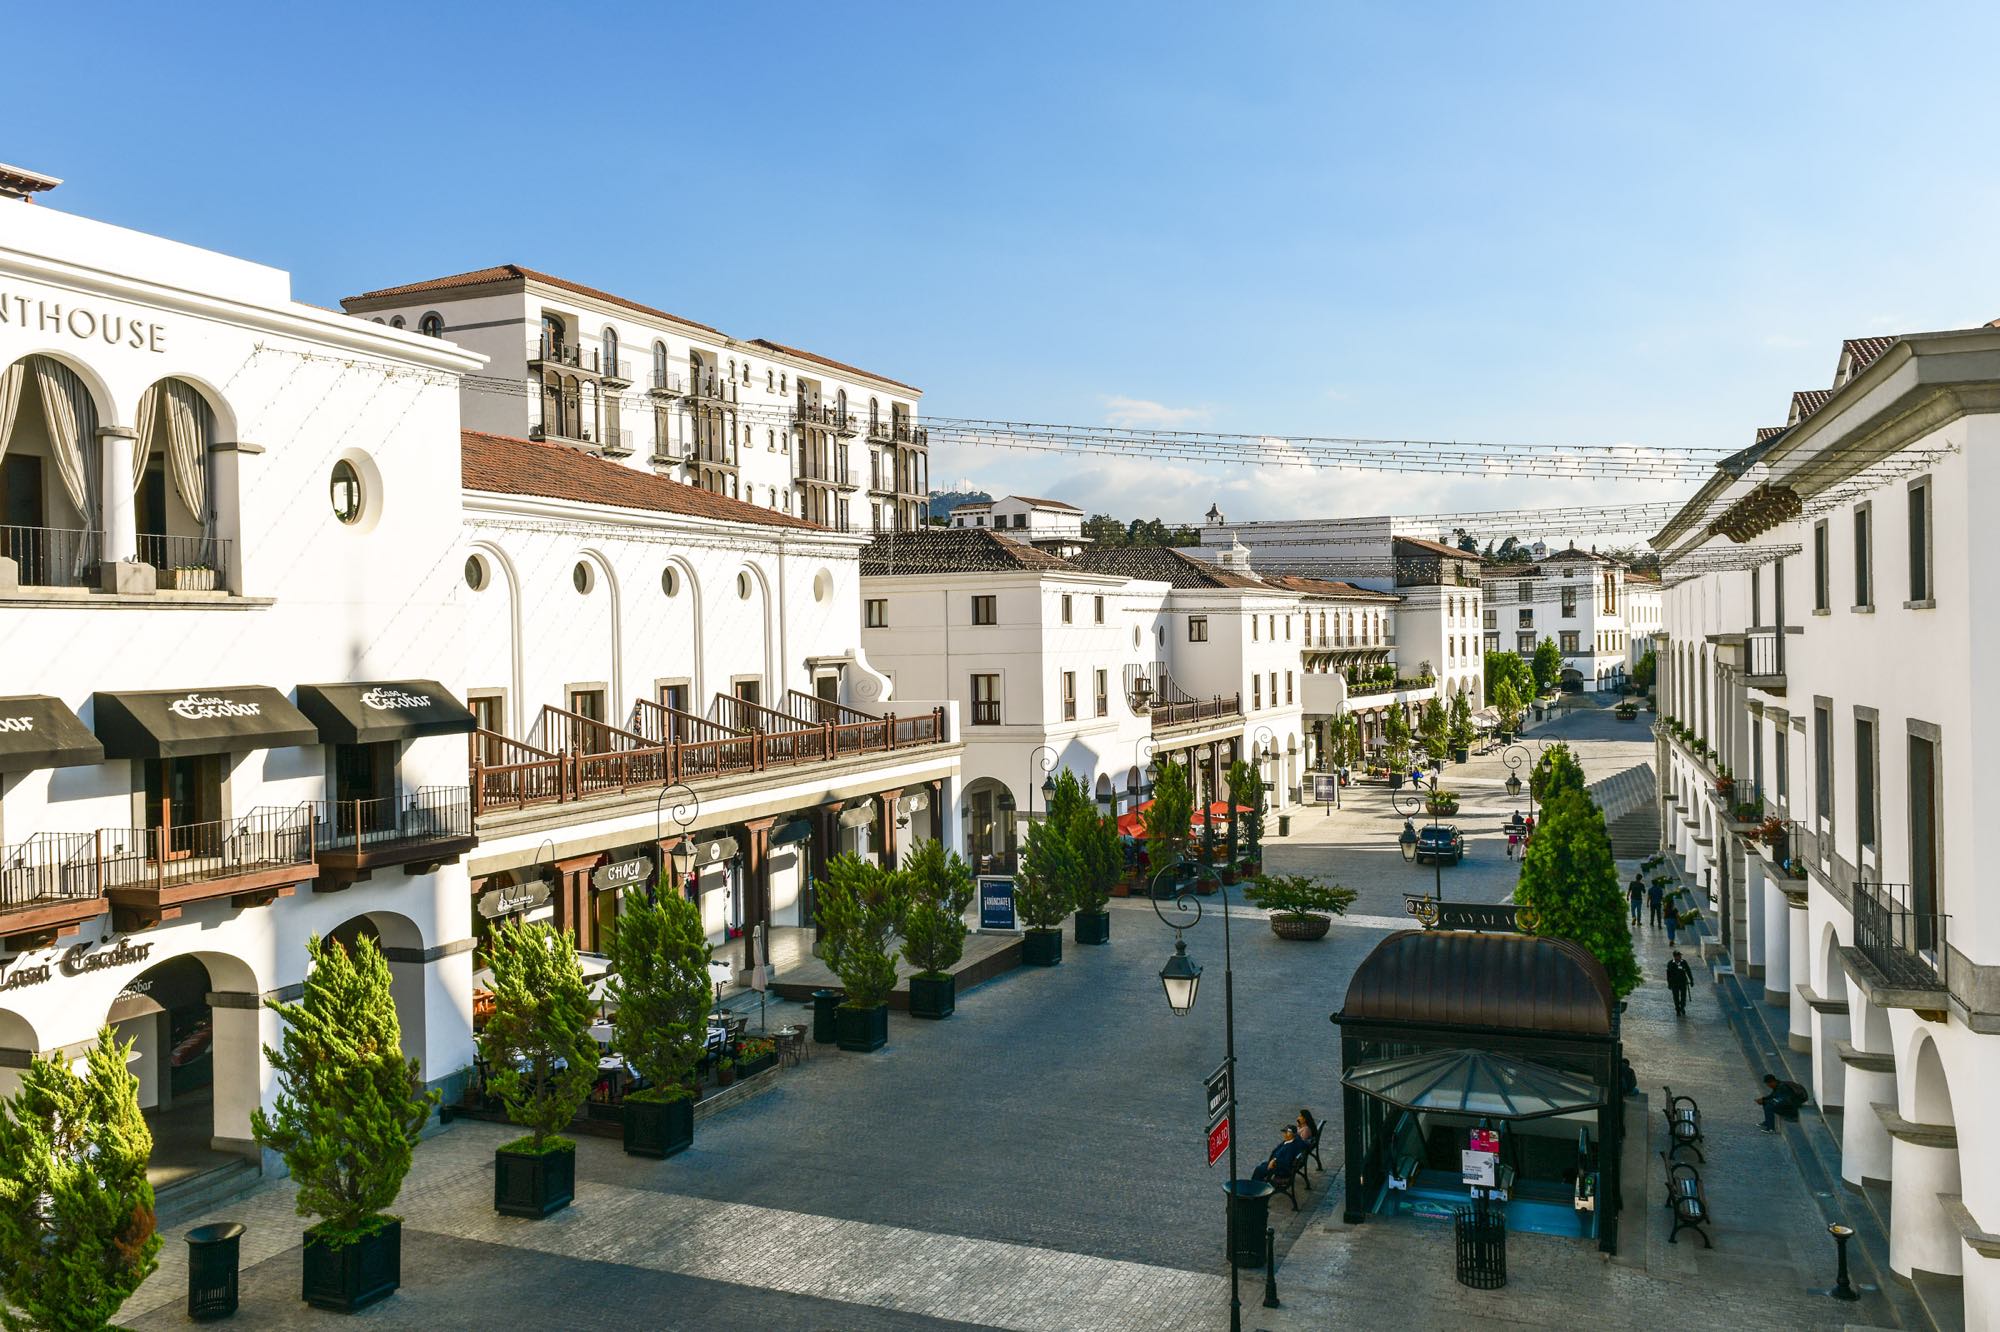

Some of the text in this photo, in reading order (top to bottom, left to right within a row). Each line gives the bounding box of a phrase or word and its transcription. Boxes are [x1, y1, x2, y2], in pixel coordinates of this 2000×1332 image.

[187, 694, 223, 705] Casa
[360, 692, 431, 710] Escobar
[373, 687, 401, 697] Casa
[168, 699, 260, 719] Escobar
[53, 938, 155, 978] Escobar
[1216, 1126, 1228, 1148] ALTO
